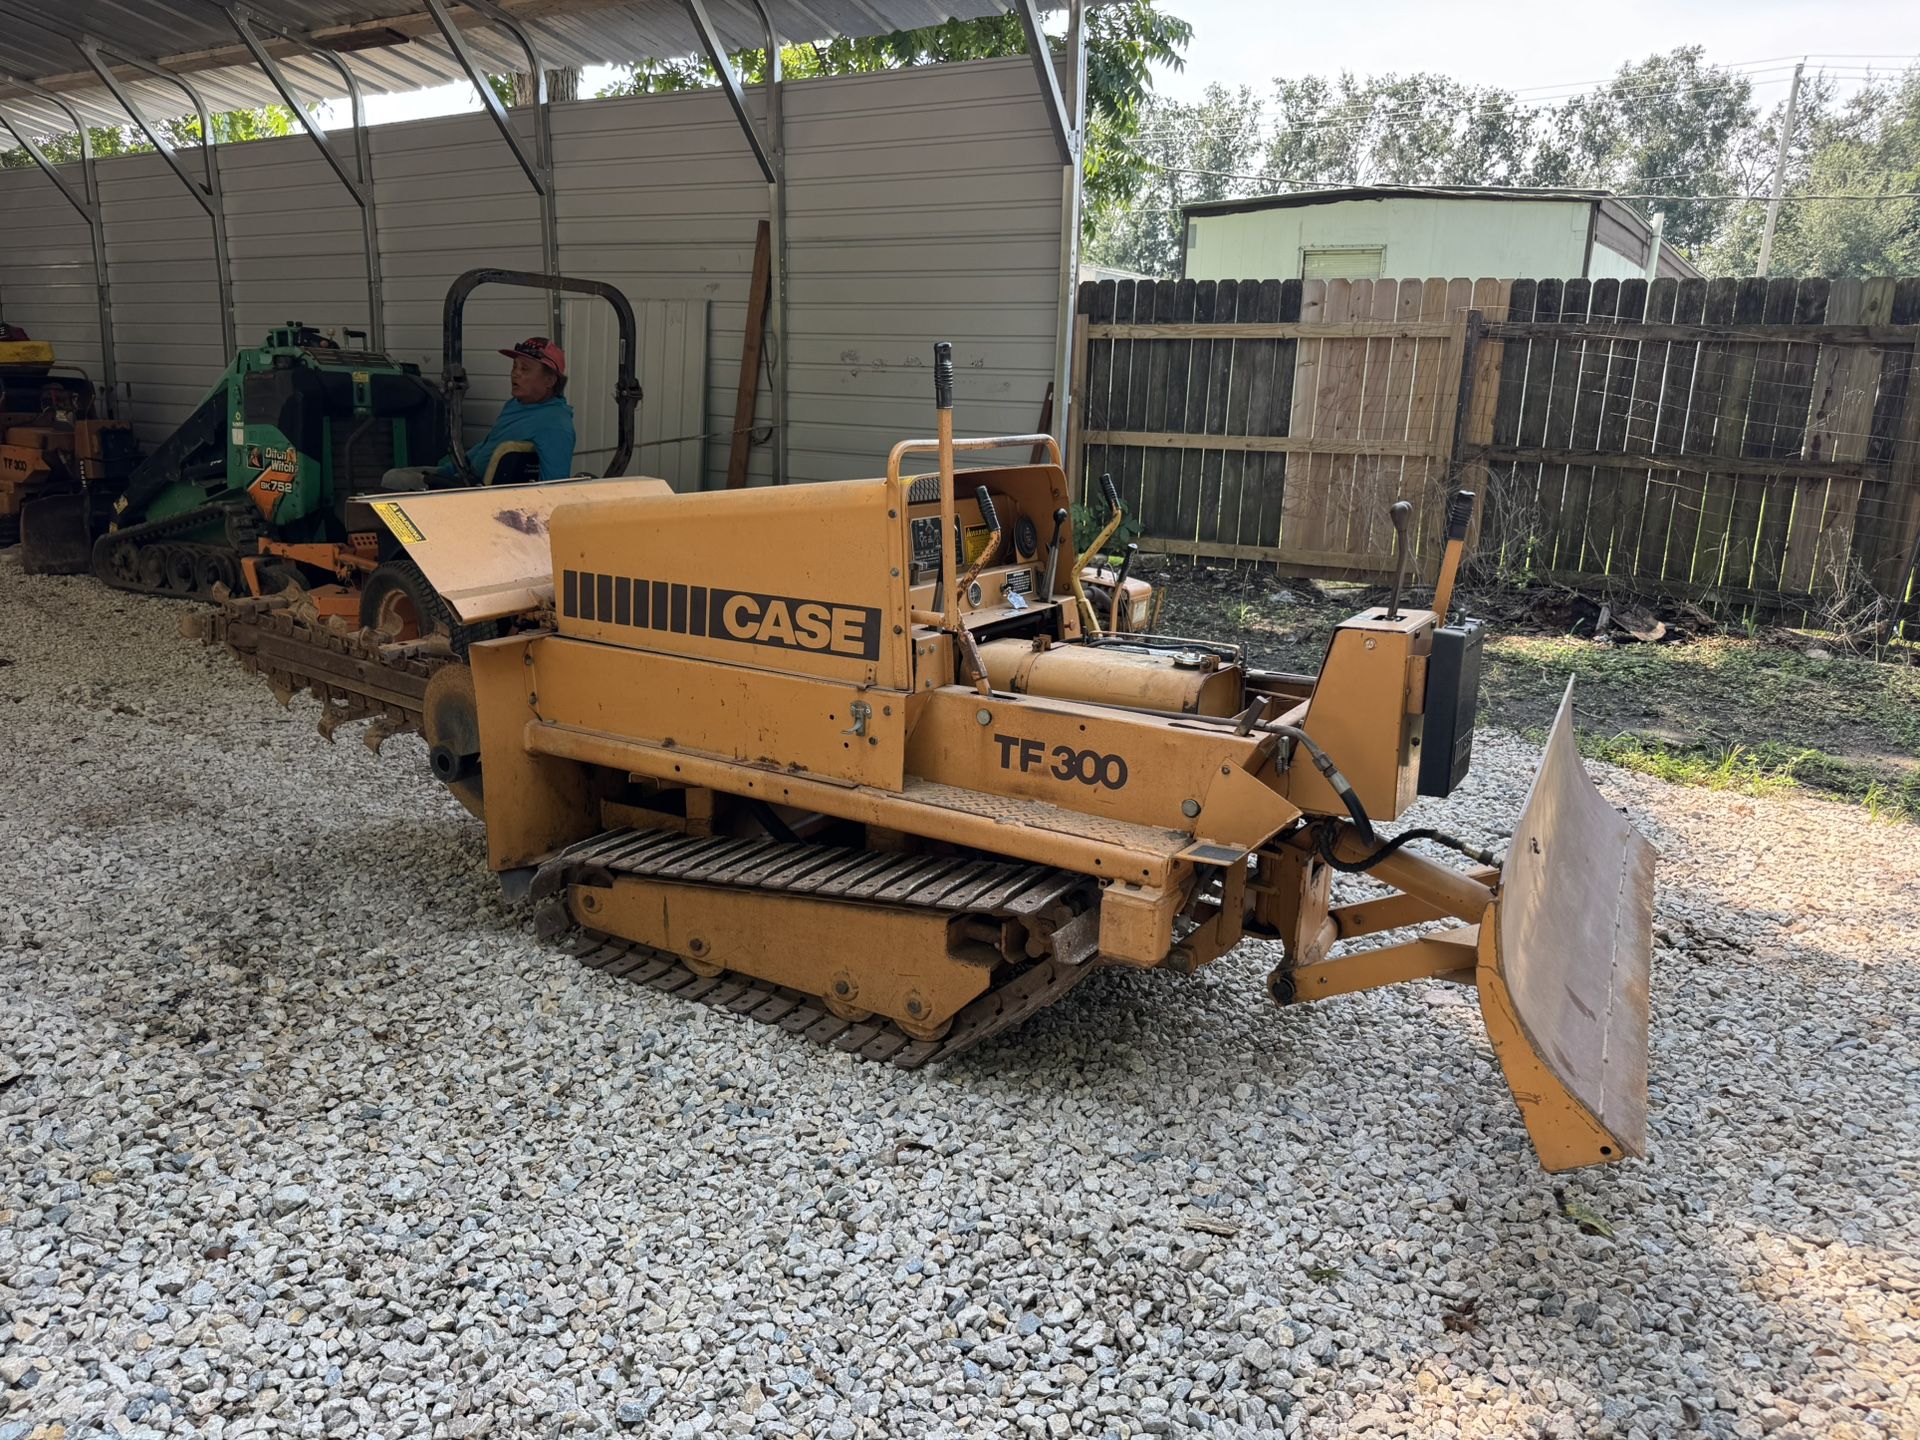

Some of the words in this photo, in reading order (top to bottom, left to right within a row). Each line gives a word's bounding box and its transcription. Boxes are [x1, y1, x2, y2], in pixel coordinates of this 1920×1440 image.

[265, 447, 288, 460] Ditch
[271, 459, 294, 473] Witch
[722, 594, 867, 655] CASE
[993, 733, 1046, 773] TF
[1050, 745, 1128, 790] 300
